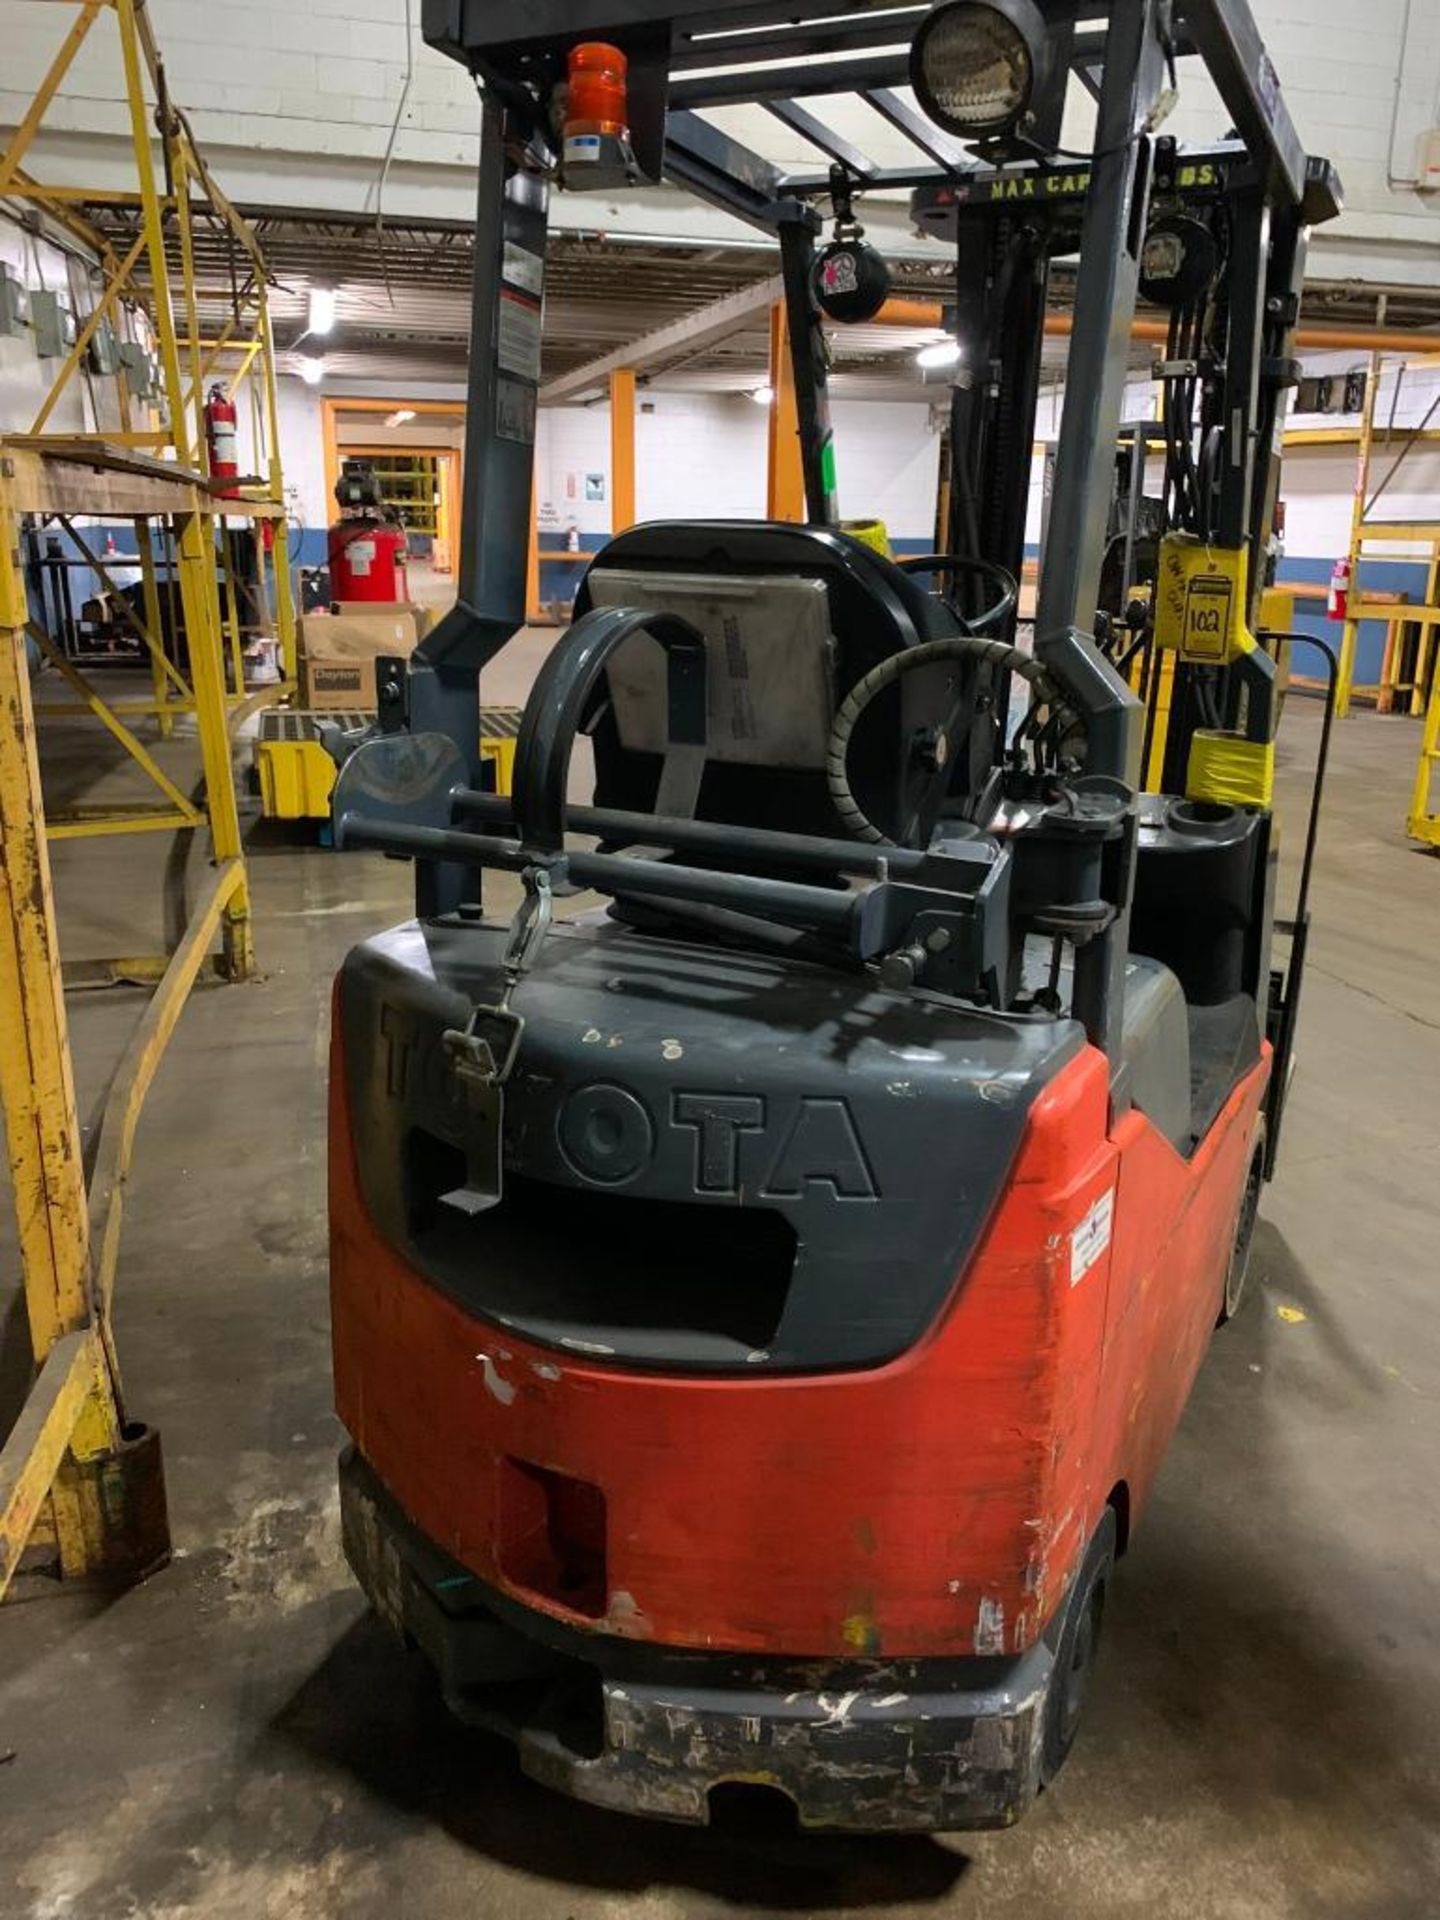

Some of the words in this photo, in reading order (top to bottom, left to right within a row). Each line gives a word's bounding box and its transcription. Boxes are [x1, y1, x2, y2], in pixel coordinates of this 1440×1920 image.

[991, 177, 1035, 200] MAX
[1190, 608, 1220, 633] 102
[314, 669, 360, 682] Dayton
